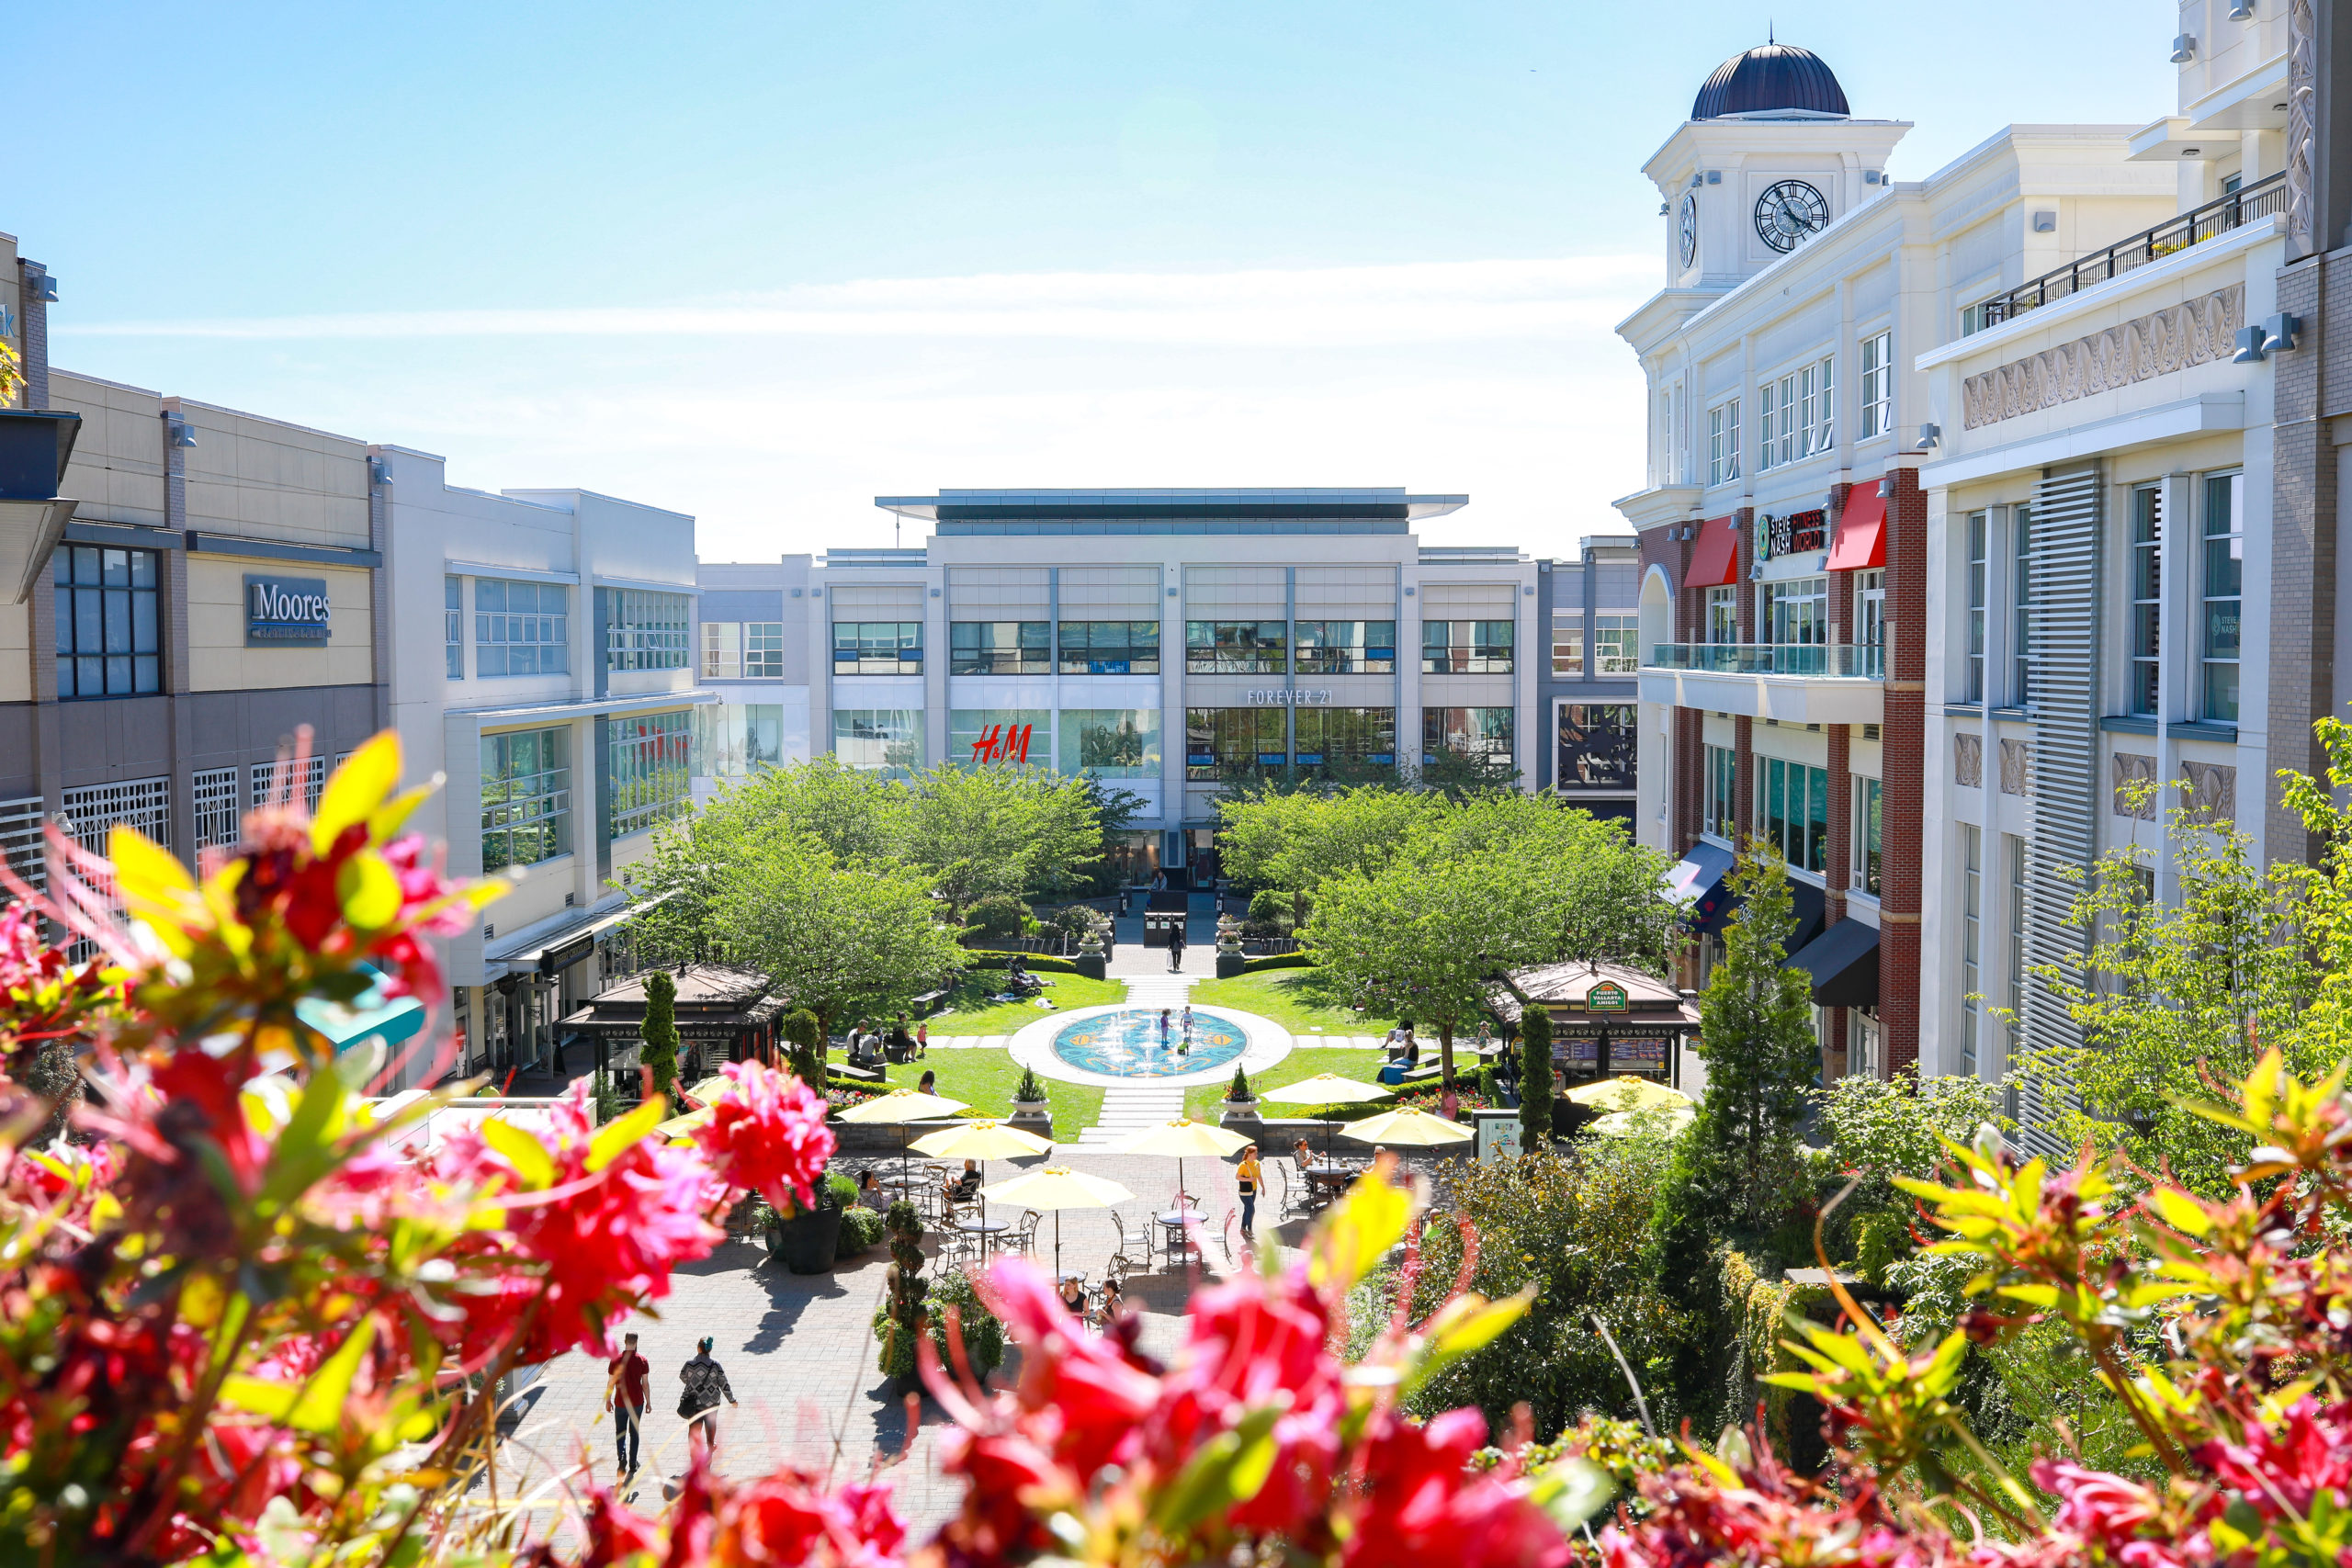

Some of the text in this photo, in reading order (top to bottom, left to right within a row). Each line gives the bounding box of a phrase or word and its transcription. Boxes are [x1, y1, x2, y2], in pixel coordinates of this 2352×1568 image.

[1771, 515, 1791, 535] STEVE
[1792, 509, 1820, 532] FITNESS
[1771, 535, 1791, 557] NASH
[1792, 530, 1820, 553] WORLD
[257, 583, 331, 622] Moores
[2221, 625, 2237, 634] NASH
[1248, 690, 1332, 705] FOREVER 21
[971, 724, 1032, 764] H&M
